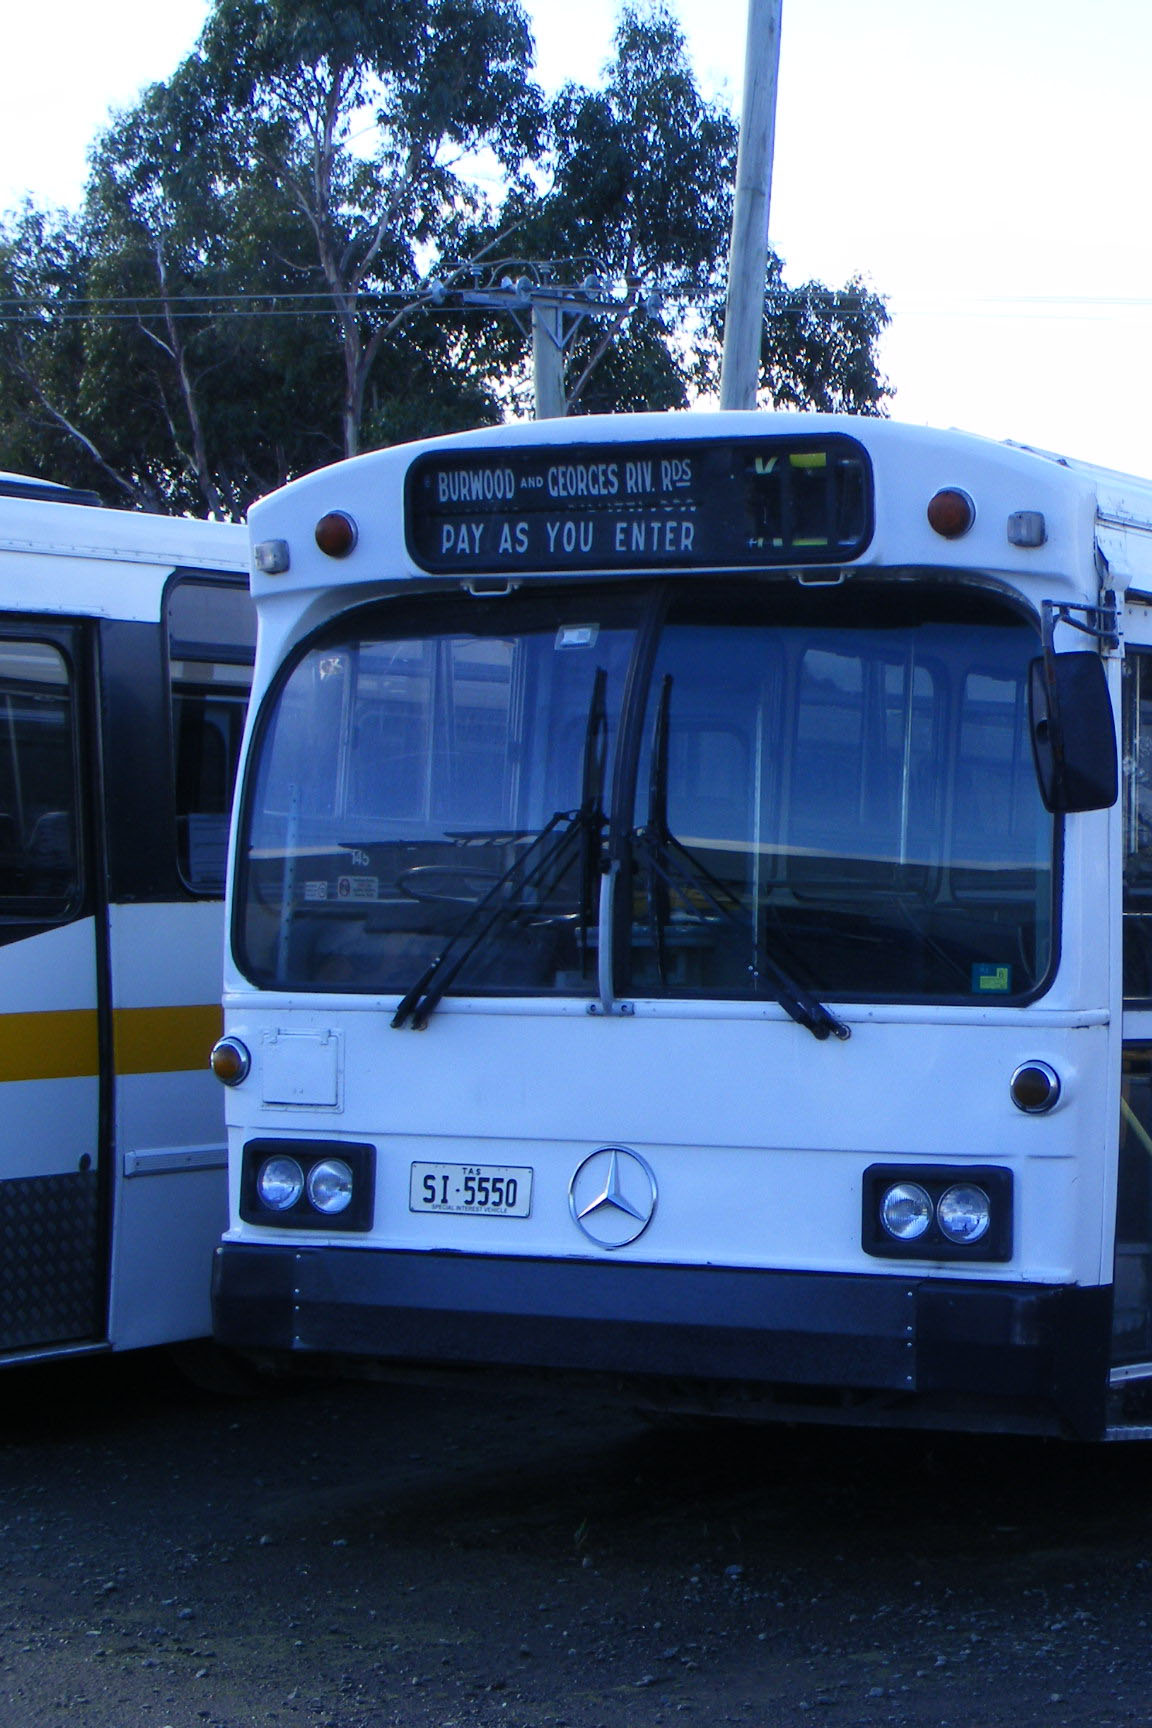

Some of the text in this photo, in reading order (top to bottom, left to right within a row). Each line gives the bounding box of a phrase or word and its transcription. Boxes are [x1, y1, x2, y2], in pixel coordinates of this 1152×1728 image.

[438, 468, 515, 502] BURWOOD
[520, 476, 544, 489] AND
[548, 463, 619, 497] GEORGES
[626, 461, 655, 493] RIV.
[442, 520, 695, 554] PAY AS YOU ENTER
[462, 1167, 482, 1176] TAS
